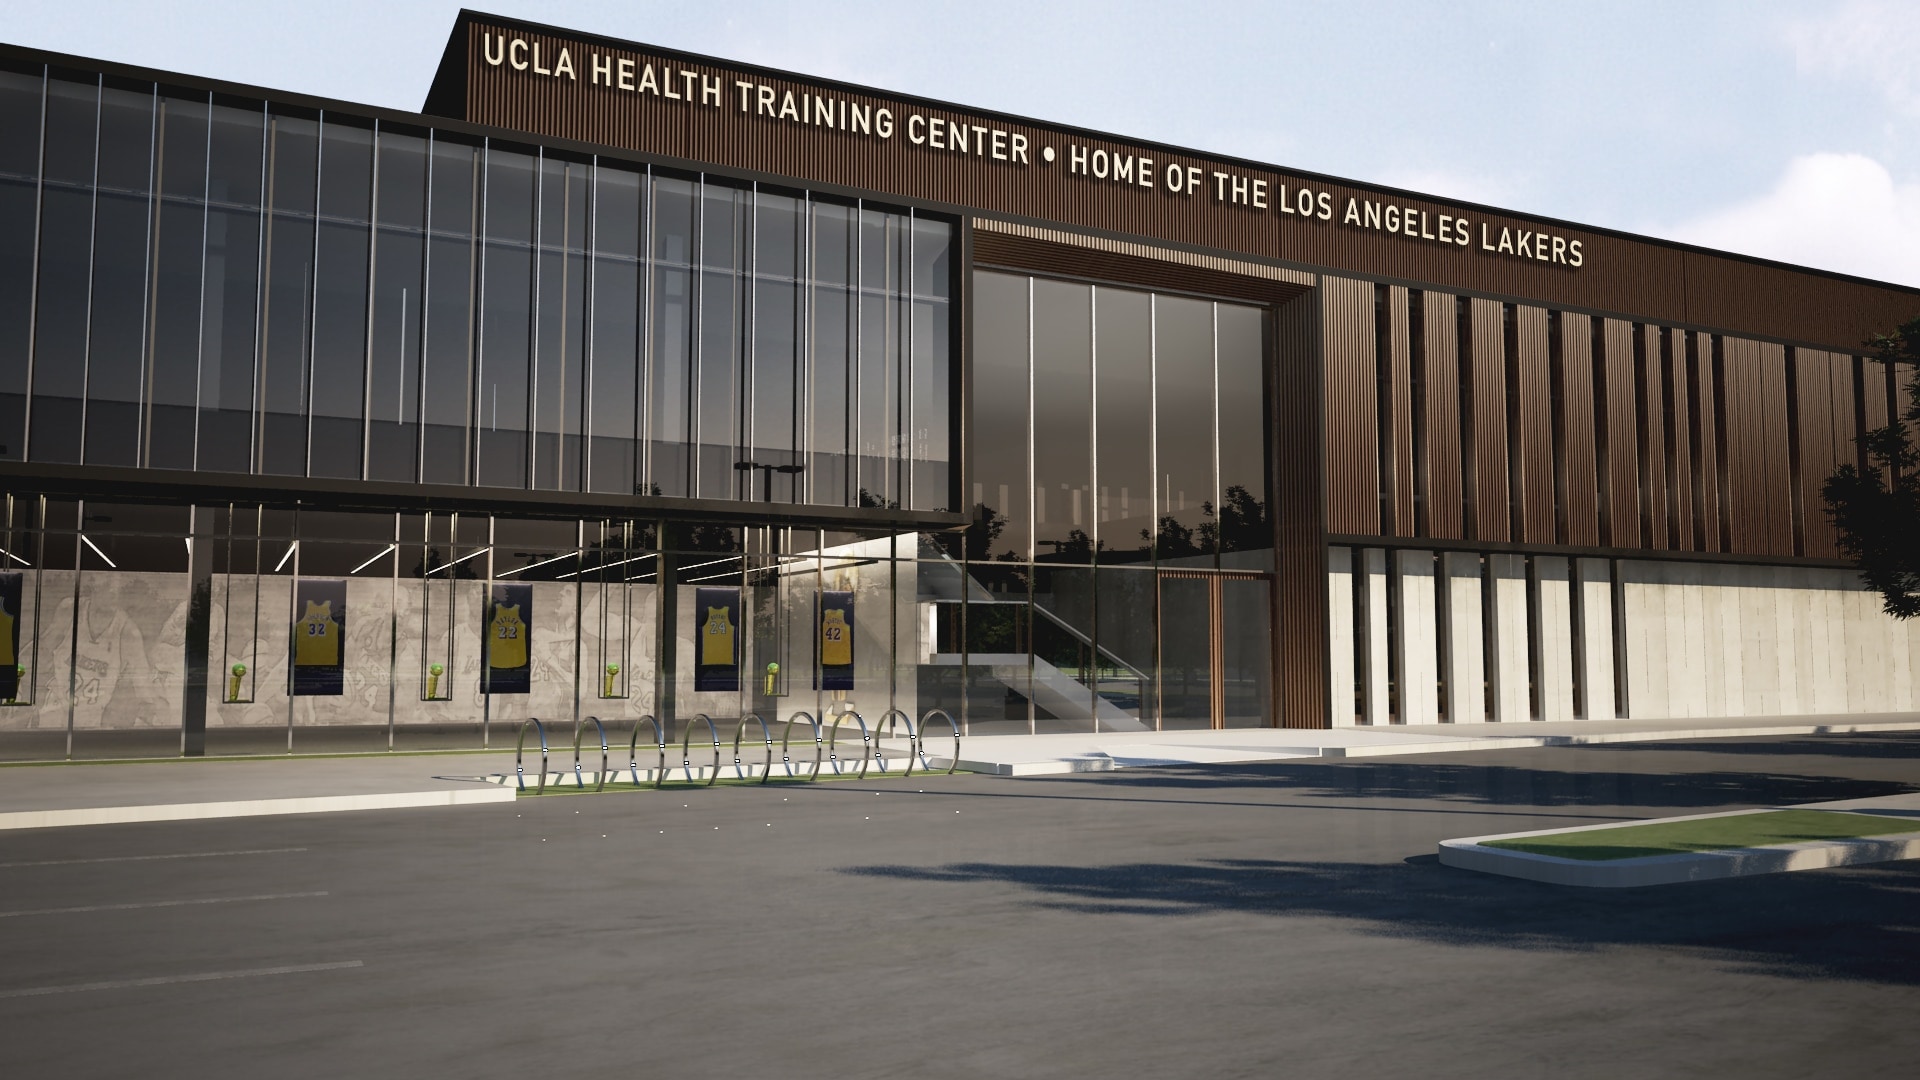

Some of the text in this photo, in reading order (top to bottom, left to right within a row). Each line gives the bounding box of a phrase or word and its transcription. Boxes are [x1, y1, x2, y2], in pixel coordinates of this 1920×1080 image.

[484, 32, 1583, 267] UCLA HEALTH TRAINING CENTER HOME OF THE LOS ANGELES LAKERS
[308, 623, 326, 636] 32
[498, 626, 518, 639] 22
[709, 621, 727, 634] 24
[825, 627, 841, 641] 42
[531, 655, 550, 683] 24
